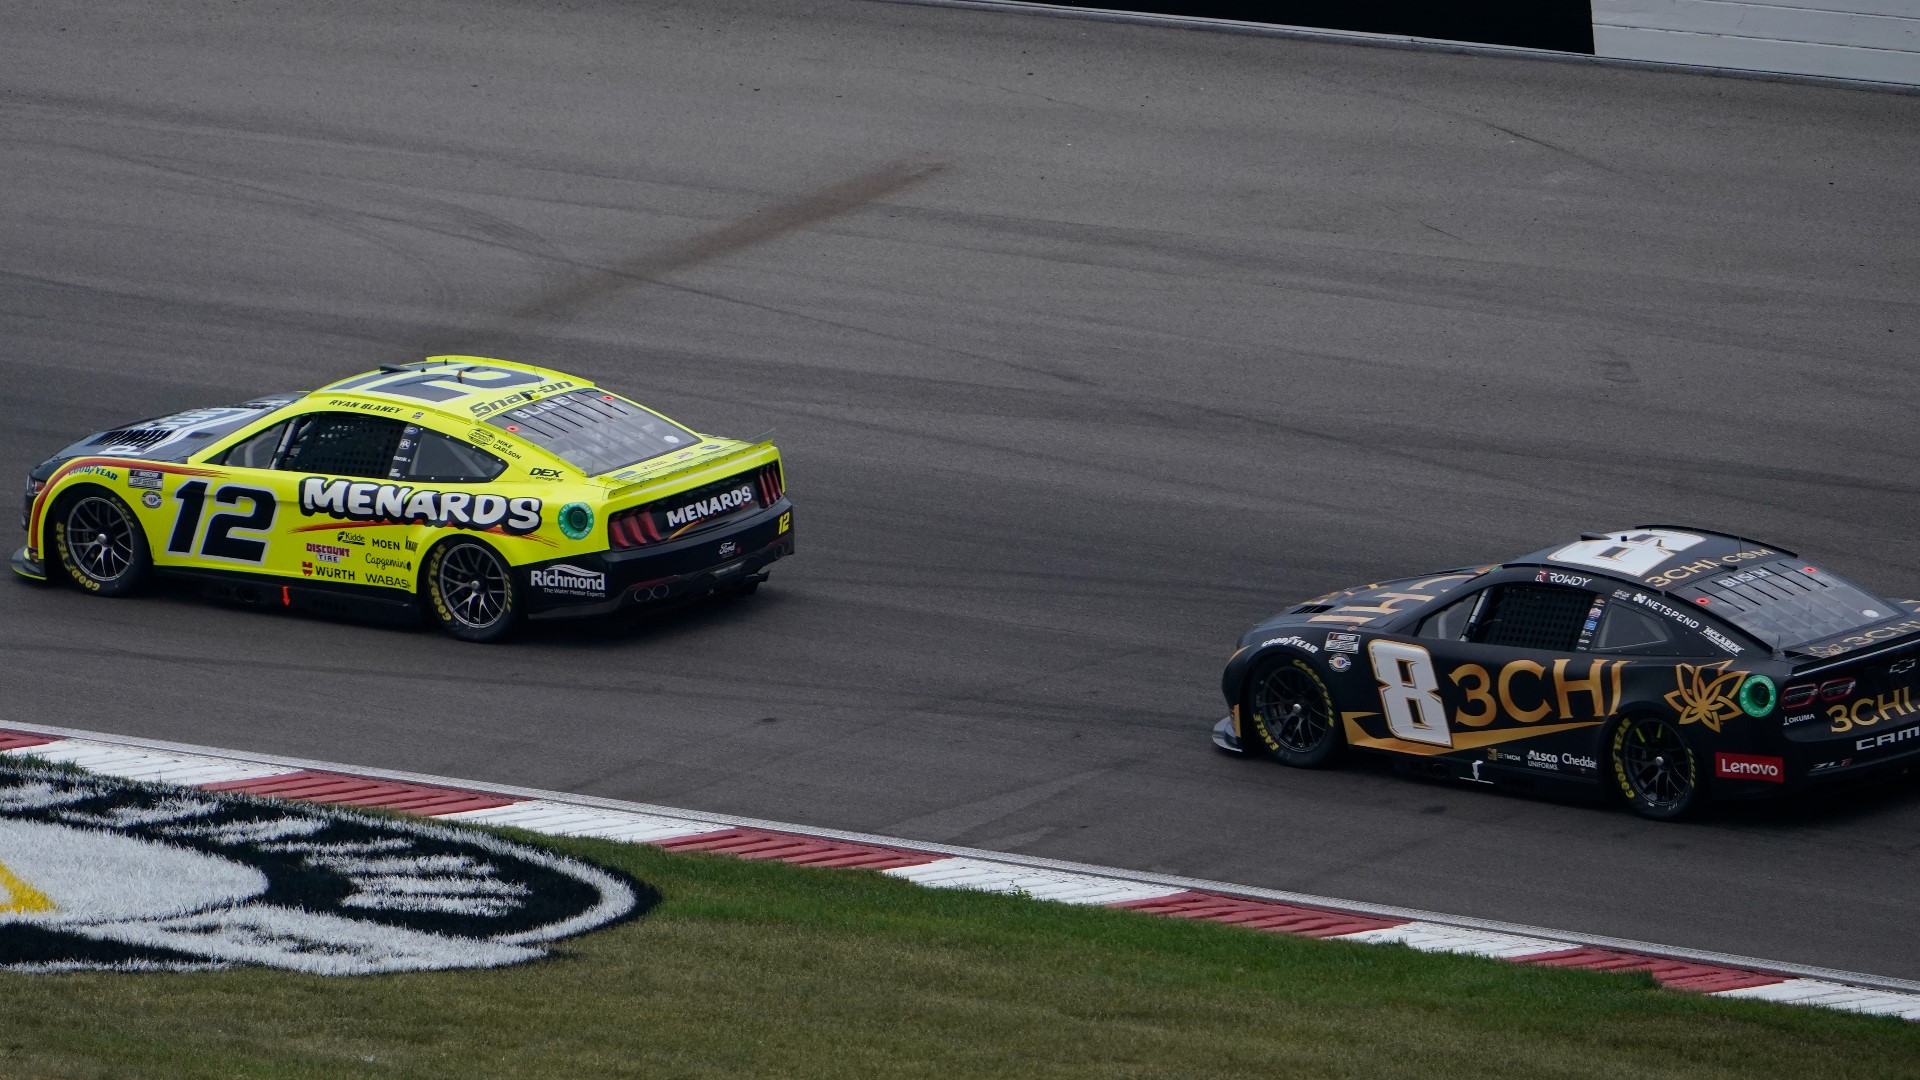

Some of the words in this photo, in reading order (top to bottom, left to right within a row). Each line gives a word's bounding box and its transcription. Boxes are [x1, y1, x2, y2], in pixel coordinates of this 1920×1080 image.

[329, 400, 360, 408] RYAN
[360, 403, 404, 415] BLANEY
[492, 443, 522, 460] CARLSON
[496, 439, 514, 448] MIKE
[68, 465, 119, 481] GOODYEAR
[529, 467, 565, 478] DEX
[299, 477, 543, 535] MENARDS
[666, 485, 753, 528] MENARDS
[164, 477, 279, 566] 12
[777, 511, 791, 535] 12
[345, 533, 365, 543] Kidde
[372, 538, 401, 551] MOEN
[306, 543, 350, 558] DISCOUNT
[318, 553, 341, 563] TIRE
[365, 553, 410, 571] Capgemini
[530, 568, 606, 591] Richmond
[1549, 572, 1593, 588] ROWDY
[1645, 597, 1700, 629] NETSPEND
[1261, 635, 1319, 654] GOODYEAR
[1367, 638, 1453, 746] 8
[1448, 658, 1636, 727] 3CHI
[1788, 713, 1816, 724] OKUMA
[1253, 712, 1280, 751] EAGLE
[1527, 749, 1559, 764] ALSCO
[1612, 716, 1637, 800] GOODYEAR
[1720, 758, 1779, 777] Lenovo
